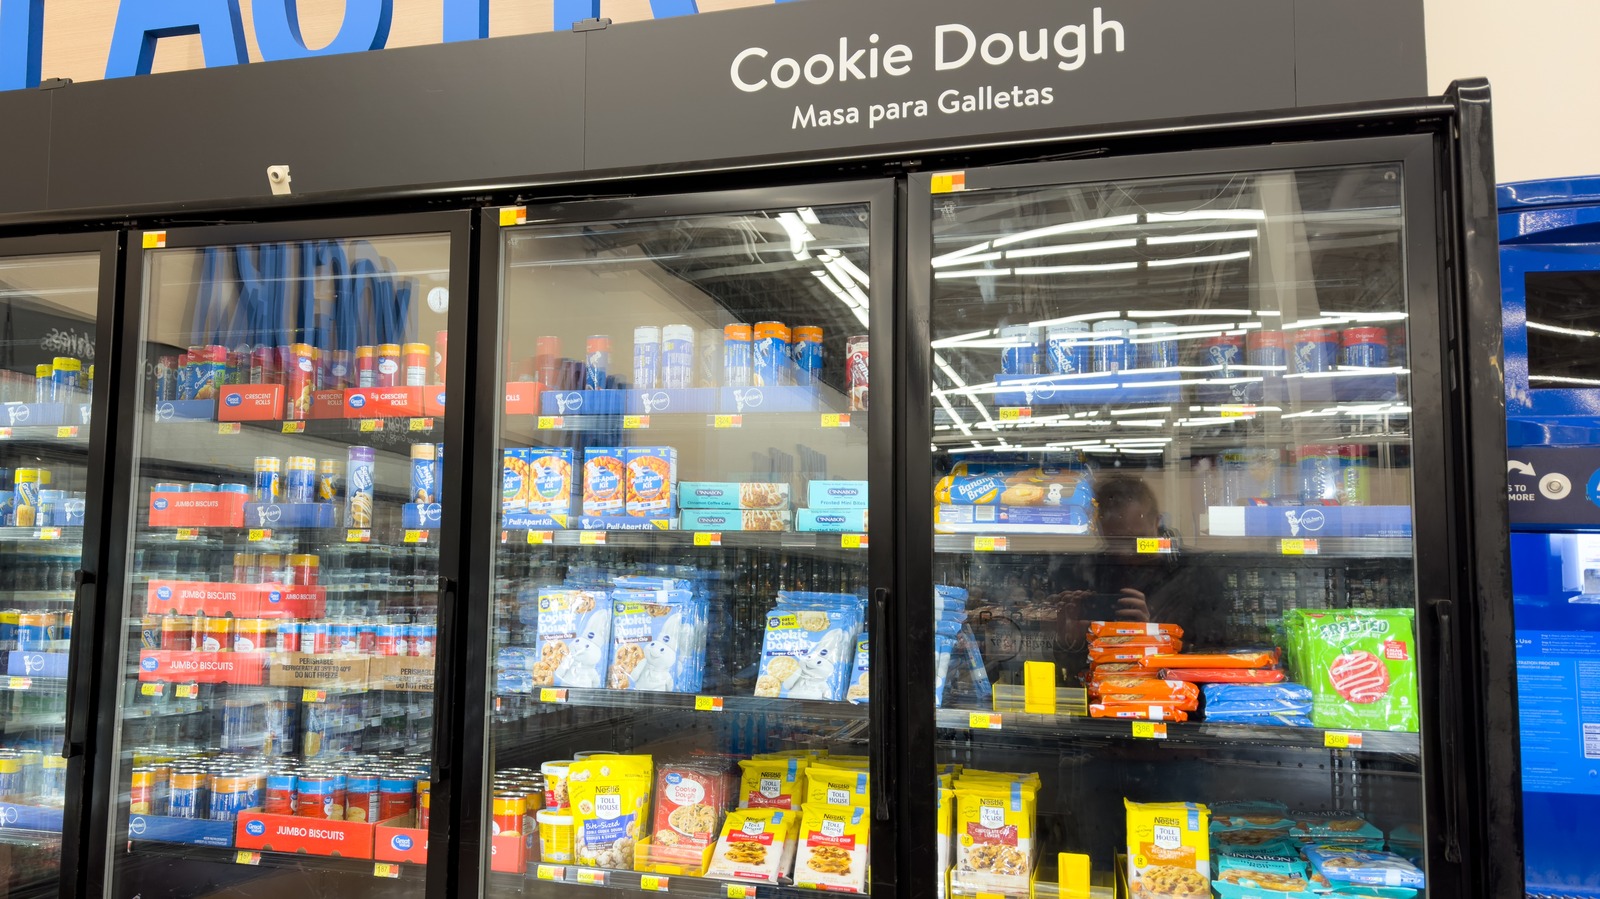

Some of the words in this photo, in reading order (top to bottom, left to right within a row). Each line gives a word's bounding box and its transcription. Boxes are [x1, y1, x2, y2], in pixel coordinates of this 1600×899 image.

[730, 33, 913, 92] Cookie
[935, 7, 1125, 71] Dough
[791, 104, 859, 129] Masa
[868, 97, 928, 129] para
[937, 84, 1054, 114] Galletas
[544, 481, 554, 489] Kit
[600, 481, 609, 489] Kit
[642, 481, 653, 489] Kit
[957, 471, 1004, 495] Banana
[967, 480, 995, 501] Bread
[1514, 484, 1527, 492] TO
[1508, 493, 1535, 501] MORE
[508, 518, 542, 527] Pull-Apart
[542, 518, 553, 526] Kit
[816, 515, 846, 523] CINNABON
[180, 591, 206, 600] JUMBO
[206, 592, 237, 601] BISCUITS
[539, 622, 577, 635] Dough
[767, 630, 809, 641] Cookie
[169, 661, 198, 670] JUMBO
[200, 661, 234, 671] BISCUITS
[299, 657, 334, 666] PERISHABLE
[294, 671, 303, 679] DO
[304, 671, 316, 679] NOT
[317, 671, 339, 679] FREEZE
[1135, 723, 1151, 735] 386
[1328, 734, 1345, 745] 368
[674, 785, 697, 793] Cookie
[675, 791, 696, 799] Dough
[597, 803, 619, 811] HOUSE
[247, 821, 262, 830] Great
[276, 826, 307, 838] JUMBO
[308, 828, 345, 841] BISCUITS
[1160, 827, 1175, 835] TOLL
[1156, 834, 1179, 842] HOUSE
[1221, 851, 1292, 863] CINNABON
